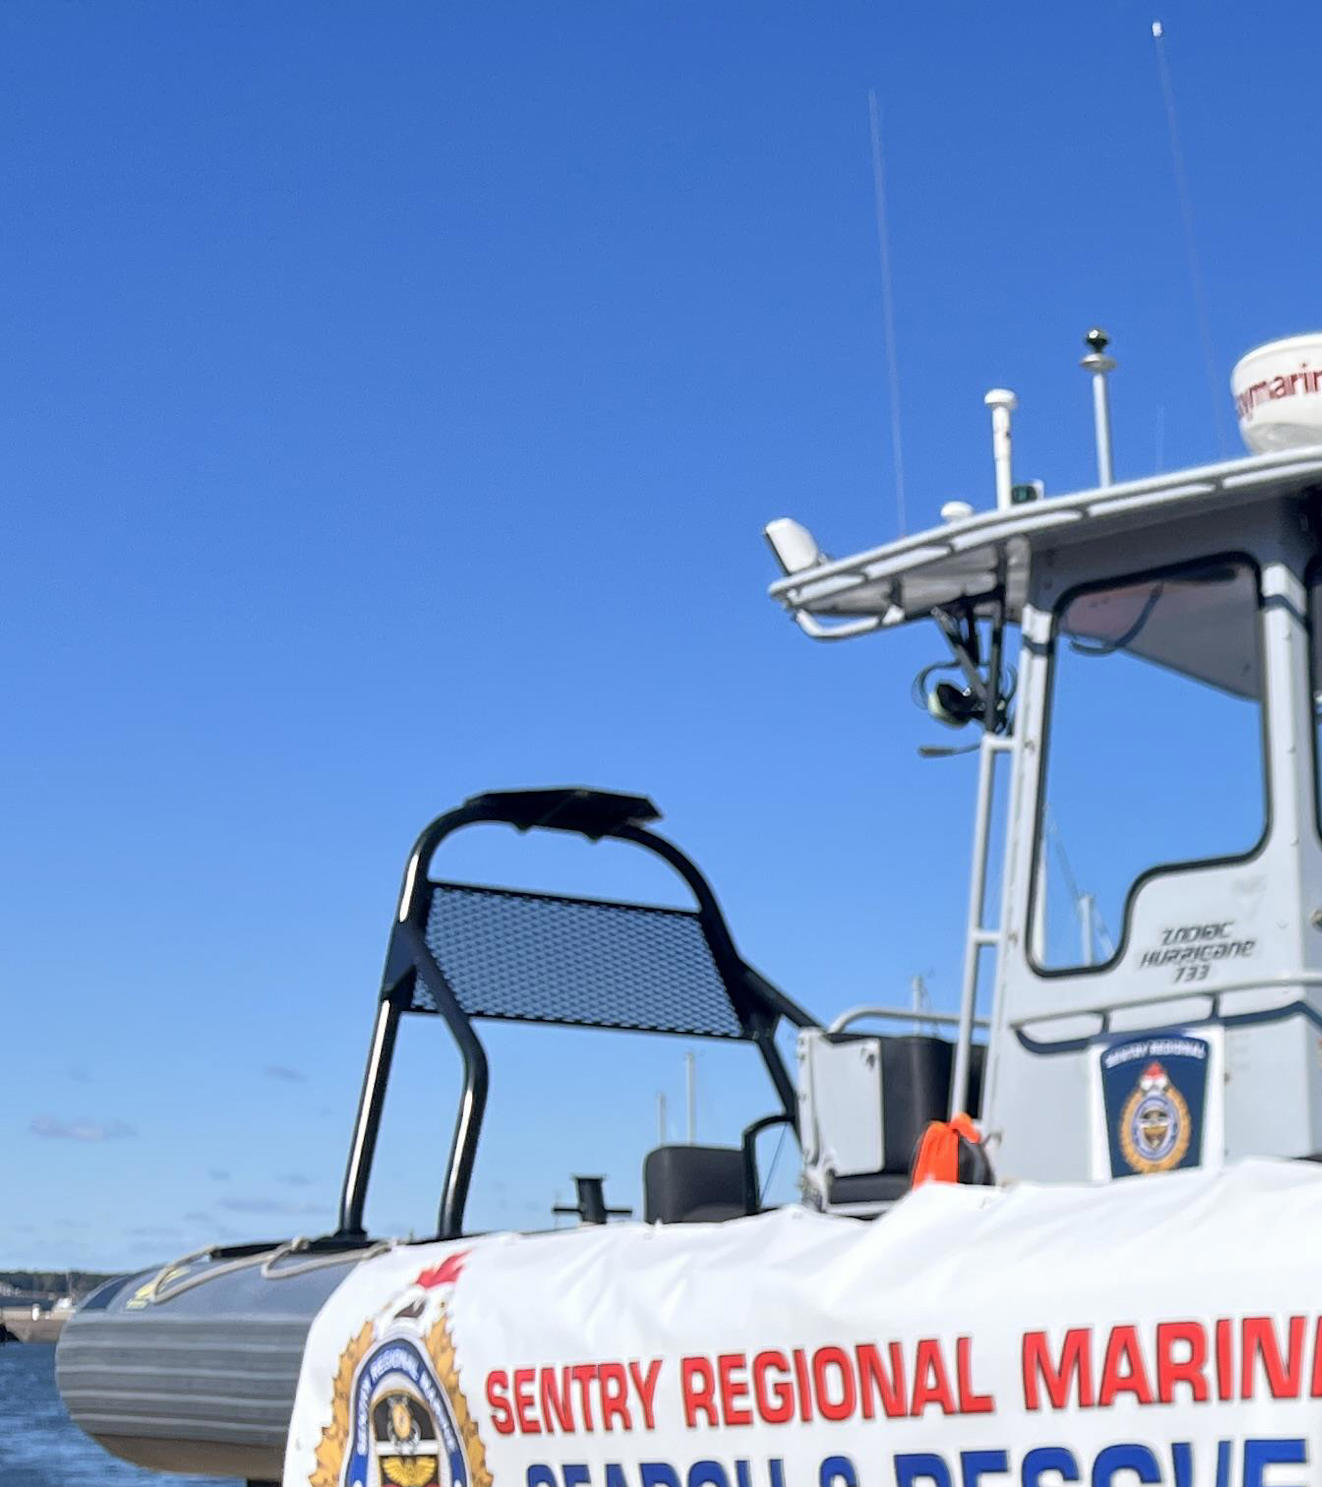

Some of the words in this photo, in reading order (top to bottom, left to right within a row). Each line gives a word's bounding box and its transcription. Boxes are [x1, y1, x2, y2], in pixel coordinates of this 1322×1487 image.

[1174, 965, 1210, 983] 733
[486, 1359, 664, 1434] SENTRY
[682, 1336, 994, 1429] REGIONAL
